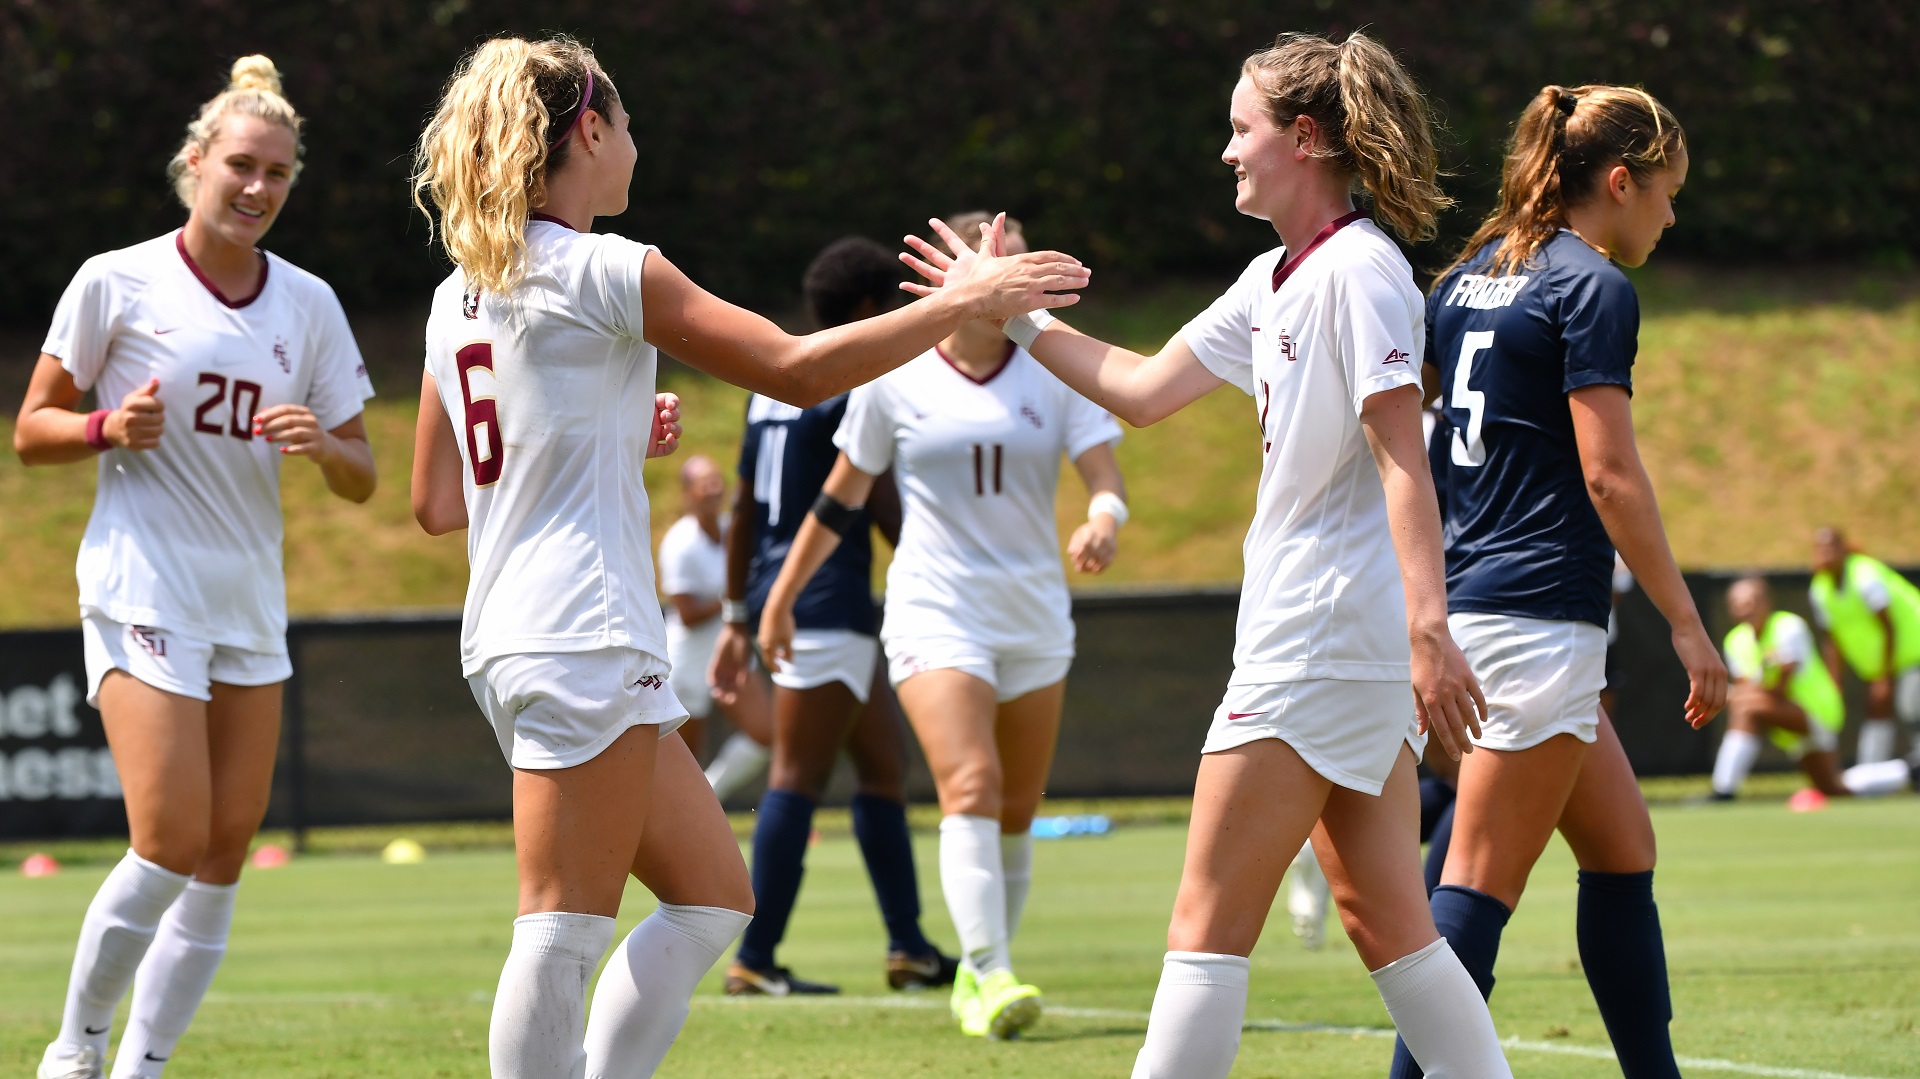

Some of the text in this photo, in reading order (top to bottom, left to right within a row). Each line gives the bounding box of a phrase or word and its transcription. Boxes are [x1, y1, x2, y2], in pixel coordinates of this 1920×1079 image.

[194, 372, 262, 442] 20
[454, 339, 504, 489] 6
[1450, 330, 1495, 467] 5
[973, 443, 1003, 496] 11
[0, 672, 82, 738] et
[0, 746, 126, 800] ess
